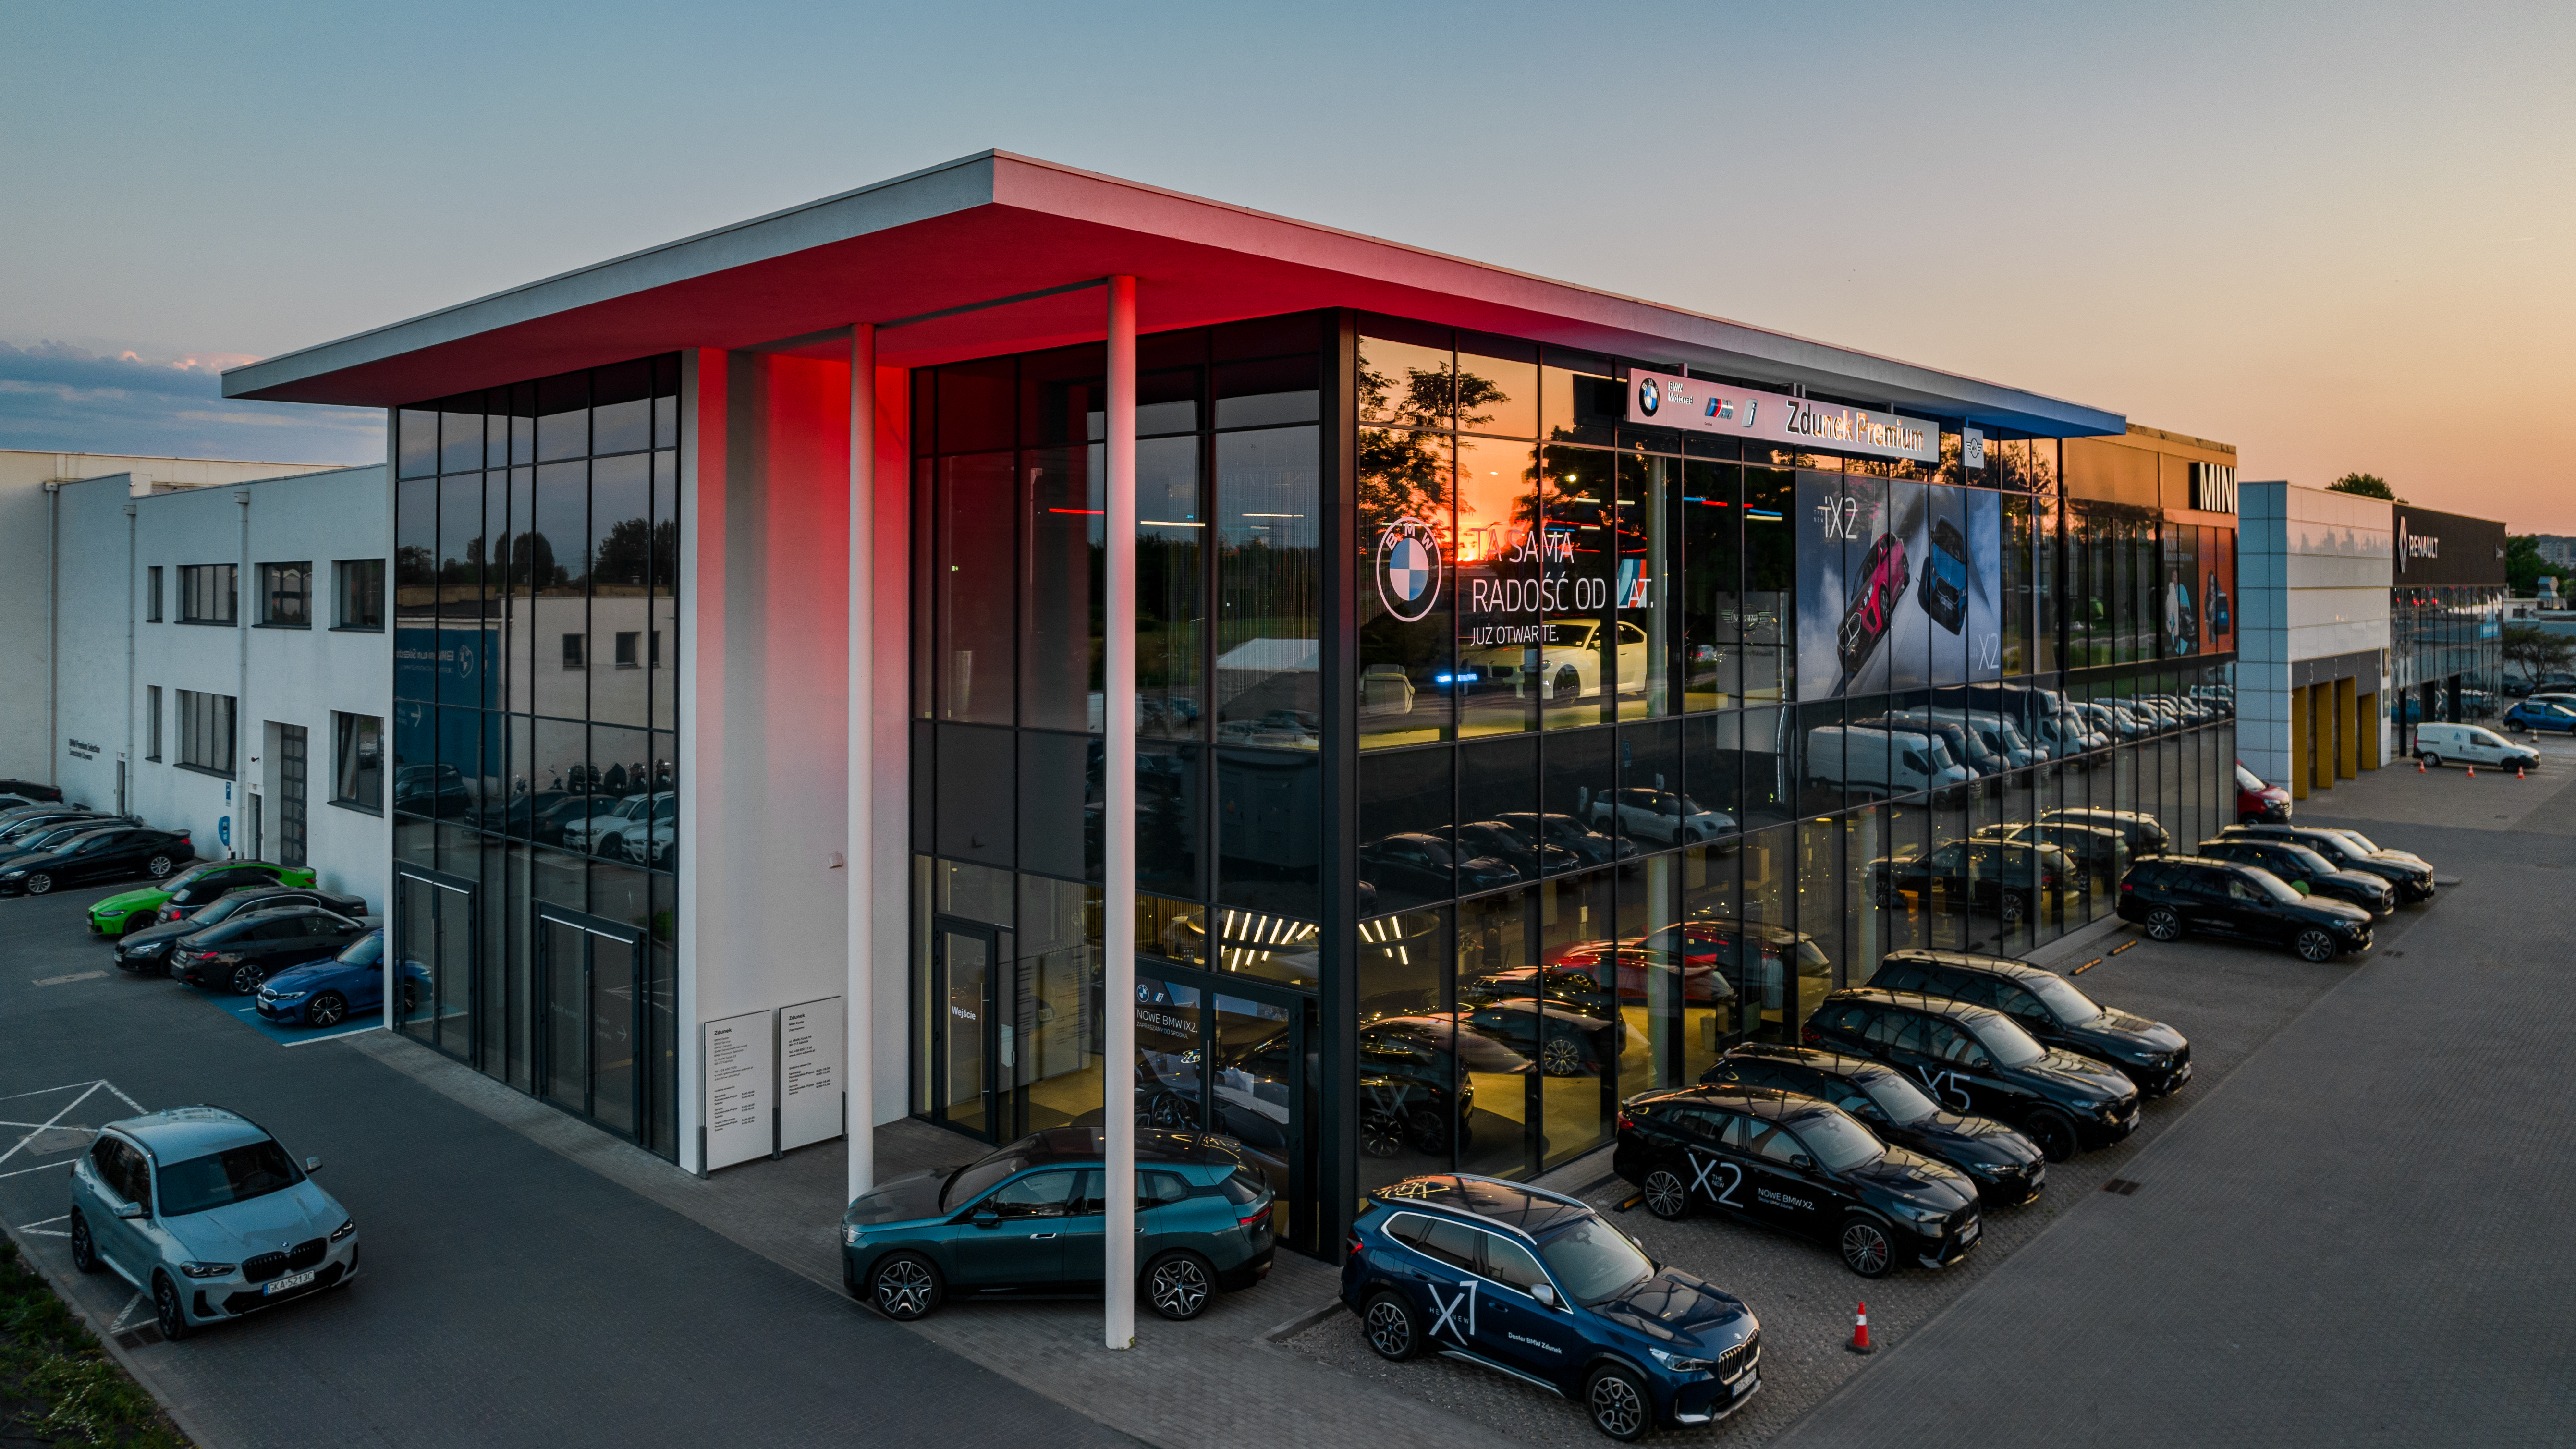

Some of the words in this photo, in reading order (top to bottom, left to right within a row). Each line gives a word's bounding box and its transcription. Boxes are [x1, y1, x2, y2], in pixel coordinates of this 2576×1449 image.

[1668, 381, 1683, 392] BMW
[1668, 392, 1693, 404] Motorrad
[1786, 400, 1854, 442] Zdunek
[1856, 412, 1924, 452] Premium
[2200, 461, 2237, 514] MINI
[1825, 496, 1857, 539] iX2
[1386, 523, 1433, 551] BMW
[1471, 528, 1502, 562] TA
[1509, 529, 1575, 563] SAMA
[2409, 535, 2438, 558] RENAULT
[1473, 572, 1569, 612] RADOŚĆ
[1576, 578, 1606, 609] OD
[1617, 578, 1654, 609] LAT.
[1471, 623, 1493, 647] JUŻ
[1496, 624, 1560, 643] OTWARTE.
[1978, 633, 1999, 670] X2
[952, 1005, 976, 1020] Wejście
[1137, 1009, 1161, 1024] NOWE
[1162, 1015, 1182, 1029] BMW
[1184, 1020, 1198, 1033] iX2.
[1136, 1021, 1164, 1033] ZAPRASZAMY
[1918, 1065, 1970, 1110] X5
[1688, 1153, 1743, 1208] X2
[1711, 1180, 1725, 1188] NEW
[1758, 1187, 1781, 1201] NOWE
[1782, 1194, 1802, 1206] BMW
[1802, 1200, 1815, 1210] X2.
[269, 1281, 285, 1292] GKA
[288, 1271, 313, 1287] 5213C
[1428, 1280, 1478, 1346] X1
[1452, 1314, 1469, 1324] NEW
[1508, 1332, 1526, 1343] Dealer
[1526, 1337, 1541, 1347] BMW
[1541, 1342, 1562, 1354] Zdunek
